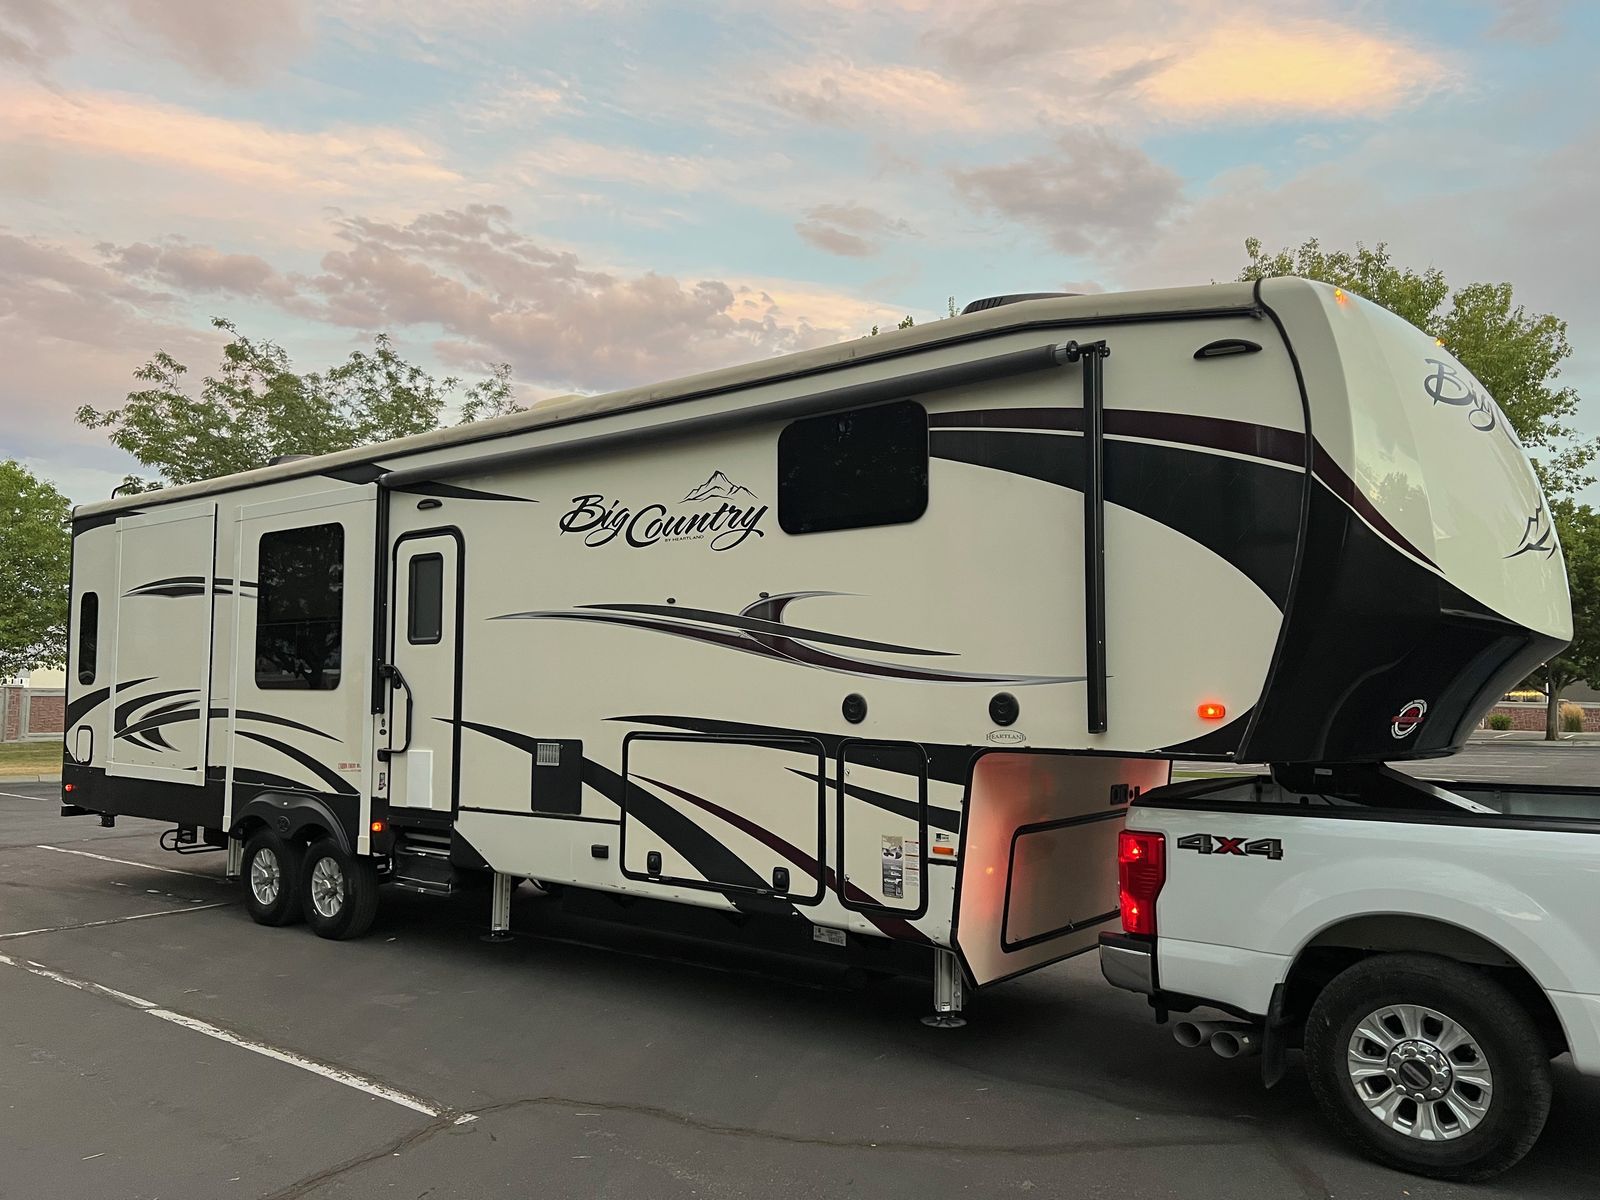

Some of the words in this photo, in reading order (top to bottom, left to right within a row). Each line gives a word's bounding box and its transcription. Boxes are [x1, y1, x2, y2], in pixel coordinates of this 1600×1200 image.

[1424, 358, 1496, 432] Big
[559, 494, 631, 548] Big
[625, 502, 769, 551] Country
[672, 534, 704, 542] HEARTLAND
